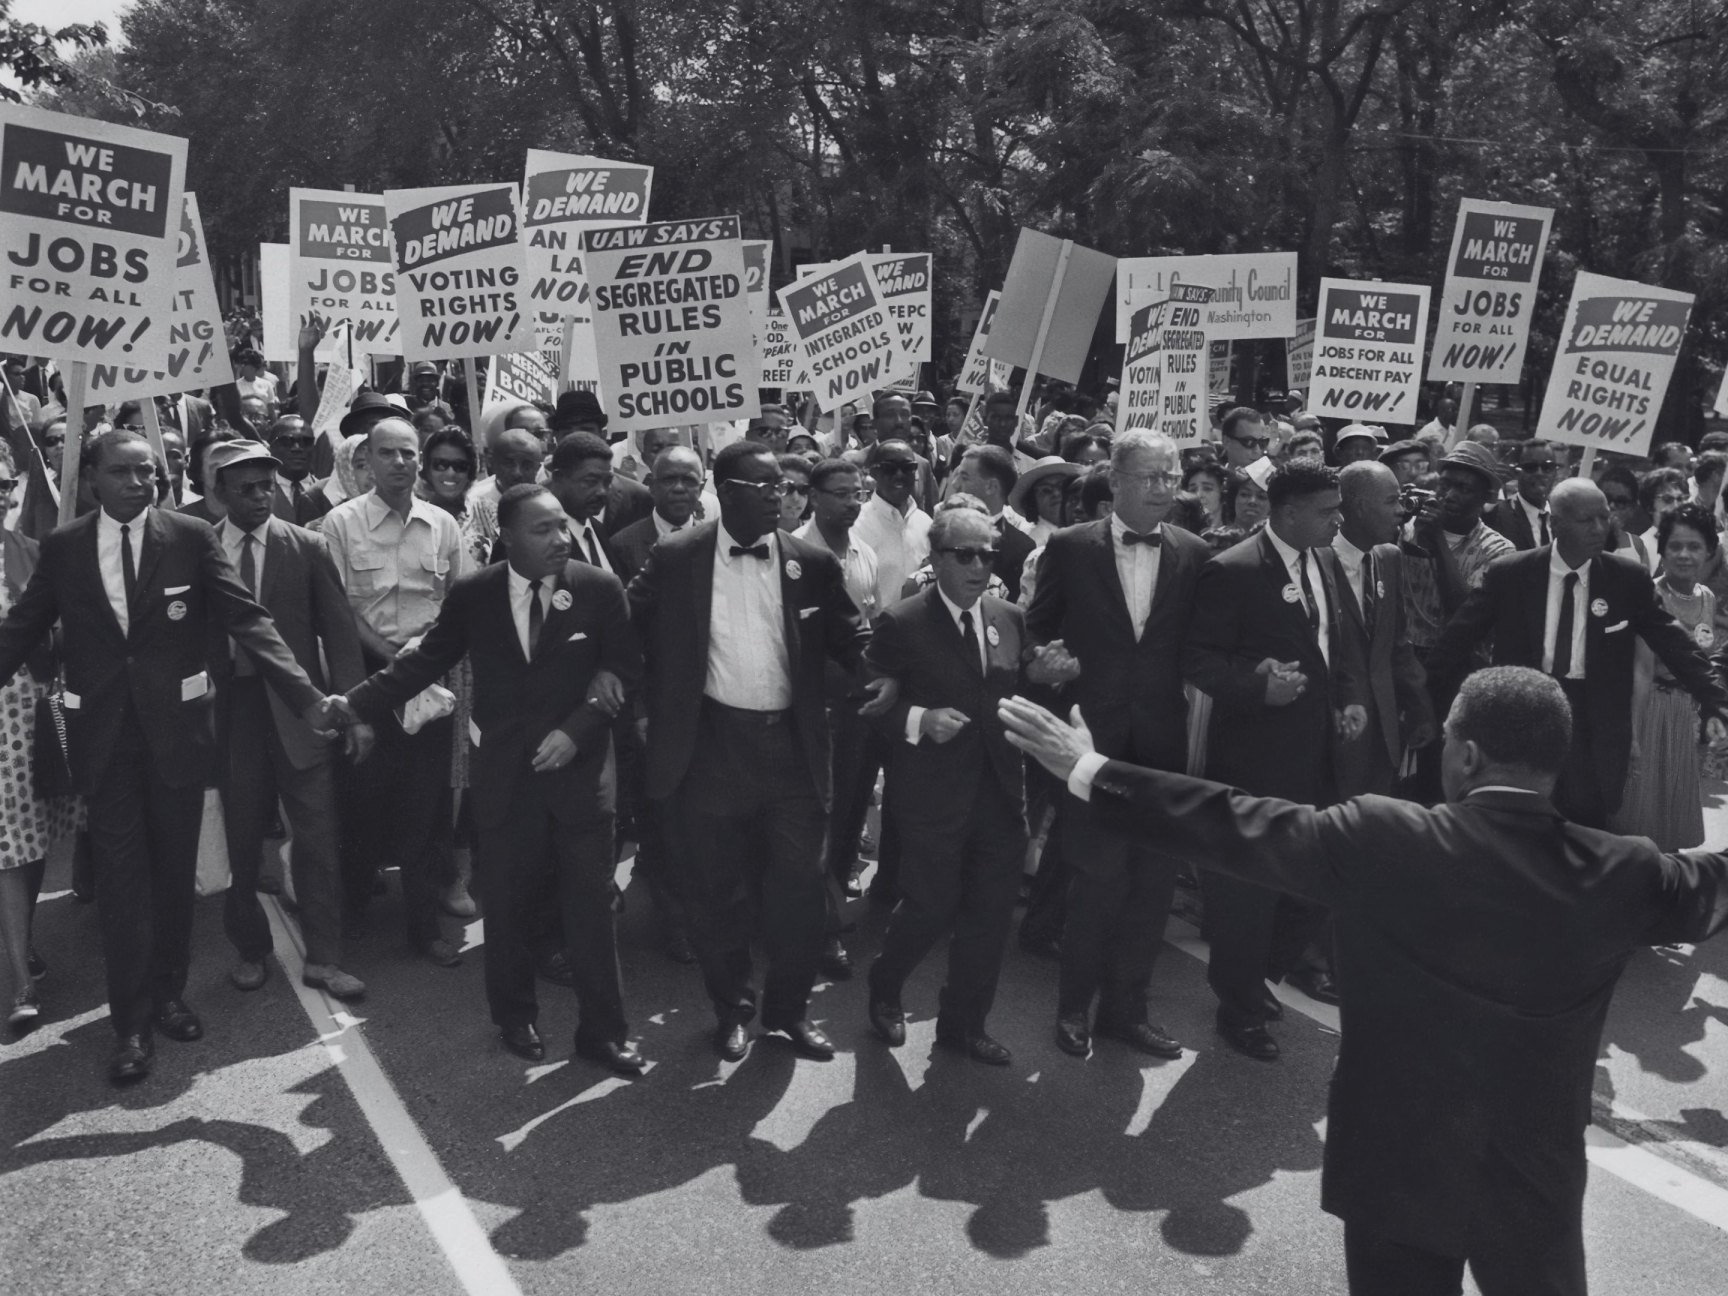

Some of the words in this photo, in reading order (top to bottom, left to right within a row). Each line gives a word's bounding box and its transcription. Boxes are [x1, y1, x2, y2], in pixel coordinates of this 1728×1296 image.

[65, 142, 114, 172] WE
[13, 162, 156, 212] MARCH
[566, 171, 610, 194] WE
[58, 203, 112, 224] FOR
[338, 207, 370, 224] WE
[431, 198, 474, 229] WE
[532, 192, 640, 220] DEMAND
[404, 214, 512, 265] DEMAND
[529, 229, 567, 250] AN
[591, 228, 649, 249] UAW
[654, 220, 734, 244] SAYS:
[1493, 219, 1517, 239] WE
[8, 232, 149, 283] JOBS
[336, 248, 372, 259] FOR
[1463, 238, 1534, 265] MARCH
[551, 254, 583, 275] LA
[614, 248, 712, 280] END
[877, 261, 904, 280] WE
[1482, 265, 1509, 277] FOR
[10, 275, 72, 297] FOR
[89, 287, 141, 306] ALL
[308, 269, 396, 296] JOBS
[408, 266, 519, 292] VOTING
[812, 278, 838, 298] WE
[879, 273, 925, 294] MAND
[1248, 267, 1291, 302] Council
[311, 297, 350, 308] FOR
[361, 300, 394, 311] ALL
[596, 274, 740, 311] SEGREGATED
[799, 281, 866, 325] MARCH
[1360, 294, 1387, 309] WE
[1453, 289, 1522, 318] JOBS
[420, 292, 517, 318] RIGHTS
[823, 308, 850, 325] FOR
[888, 305, 926, 318] FEPC
[1147, 303, 1168, 327] WE
[1612, 300, 1658, 323] WE
[1, 305, 151, 352] NOW!
[618, 304, 721, 336] RULES
[1170, 307, 1200, 327] END
[1331, 308, 1411, 330] MARCH
[1452, 321, 1482, 334] FOR
[1489, 324, 1514, 336] ALL
[422, 312, 520, 348] NOW!
[544, 336, 563, 346] FO
[804, 311, 883, 357] INTEGRATED
[1162, 330, 1205, 350] SEGREGATED
[1355, 329, 1385, 339] FOR
[1575, 324, 1680, 348] DEMAND
[654, 341, 691, 357] IN
[812, 331, 891, 376] SCHOOLS
[1319, 346, 1354, 359] JOBS
[1358, 348, 1385, 362] FOR
[1388, 351, 1414, 365] ALL
[1442, 342, 1517, 370] NOW!
[620, 353, 736, 388] PUBLIC
[778, 359, 793, 368] FO
[973, 358, 986, 366] FO
[1168, 354, 1196, 373] RULES
[1575, 355, 1652, 391] EQUAL
[500, 370, 543, 402] BOR
[829, 350, 892, 399] NOW!
[1129, 366, 1160, 384] VOTIN
[1315, 365, 1327, 377] A
[1329, 366, 1382, 381] DECENT
[1384, 370, 1413, 384] PAY
[1175, 381, 1186, 392] IN
[1566, 379, 1651, 416] RIGHTS
[617, 383, 744, 419] SCHOOLS
[1128, 389, 1159, 408] RIGHT
[1164, 394, 1196, 415] PUBLIC
[1322, 387, 1406, 412] NOW!
[1162, 418, 1196, 439] SCHOOLS
[1556, 406, 1646, 444] NOW!
